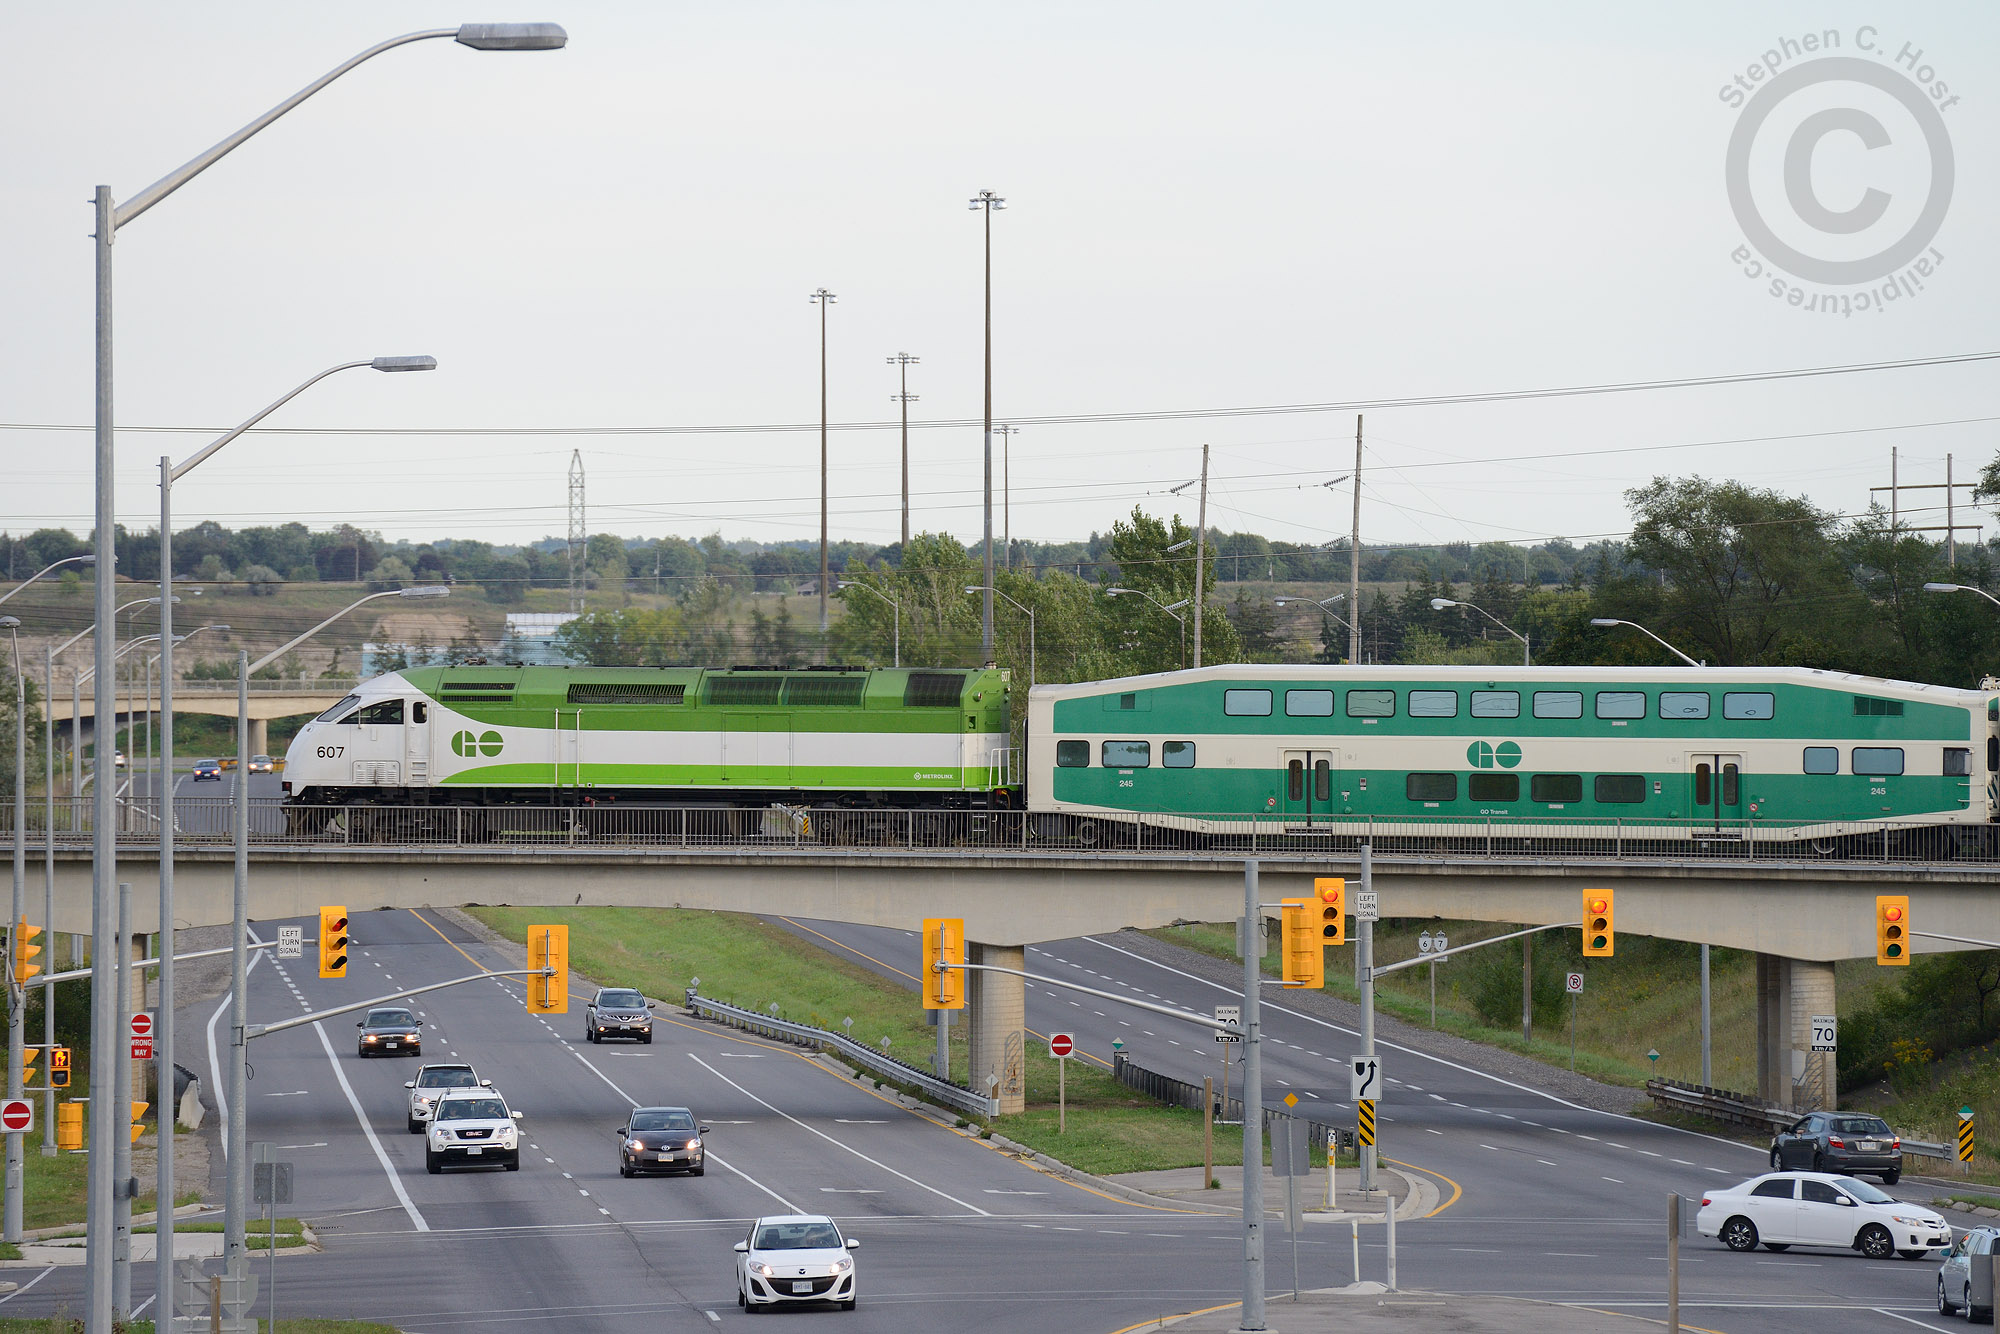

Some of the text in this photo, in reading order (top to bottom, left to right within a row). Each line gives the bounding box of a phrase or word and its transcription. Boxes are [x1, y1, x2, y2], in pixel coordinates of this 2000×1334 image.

[1001, 670, 1010, 682] 607
[451, 730, 504, 758] GO
[317, 746, 345, 759] 607
[1466, 740, 1522, 769] GO
[1119, 779, 1134, 788] 245
[1871, 787, 1886, 796] 245
[1422, 940, 1428, 948] 6
[1438, 940, 1444, 948] 7
[1813, 1027, 1835, 1042] 70
[131, 1039, 152, 1047] WRONG
[134, 1048, 148, 1057] WAY
